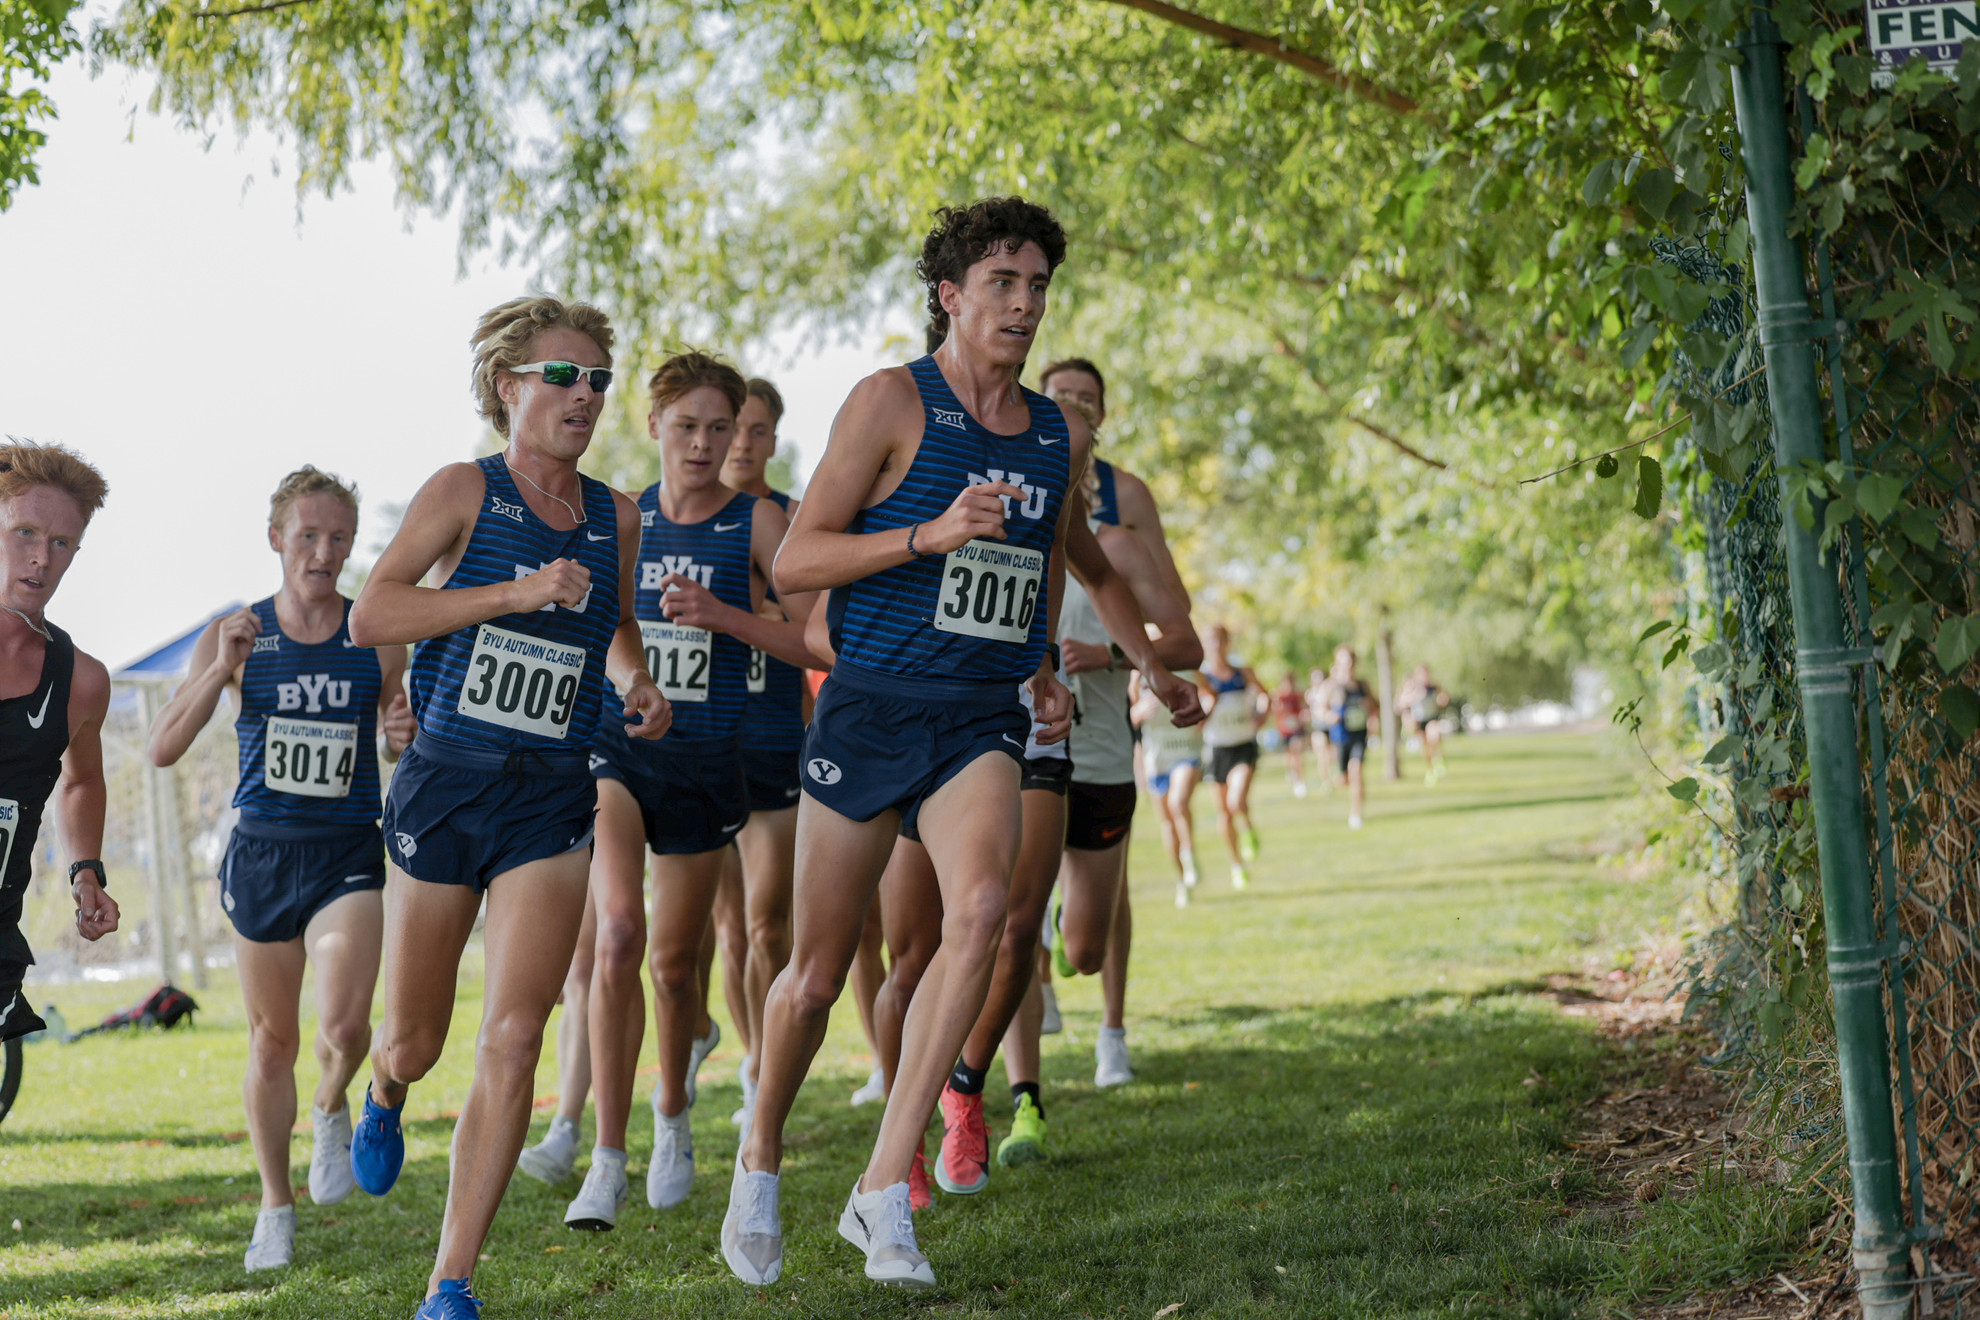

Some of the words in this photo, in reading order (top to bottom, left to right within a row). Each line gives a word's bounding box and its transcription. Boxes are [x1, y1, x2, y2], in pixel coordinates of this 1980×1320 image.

[640, 555, 714, 592] BYU
[955, 545, 978, 560] BYU
[977, 549, 1012, 566] AUTUMN
[1012, 554, 1043, 572] CLASSIC
[943, 566, 1038, 630] 3016
[482, 632, 503, 651] BYU
[503, 637, 546, 660] AUTUMN
[545, 648, 583, 669] CLASSIC
[641, 627, 673, 640] AUTUMN
[675, 630, 708, 643] CLASSIC
[277, 673, 352, 713] BYU
[467, 653, 577, 726] 3009
[273, 723, 289, 735] BYU
[289, 724, 323, 740] AUTUMN
[324, 727, 354, 741] CLASSIC
[270, 740, 353, 786] 3014
[813, 761, 836, 782] Y
